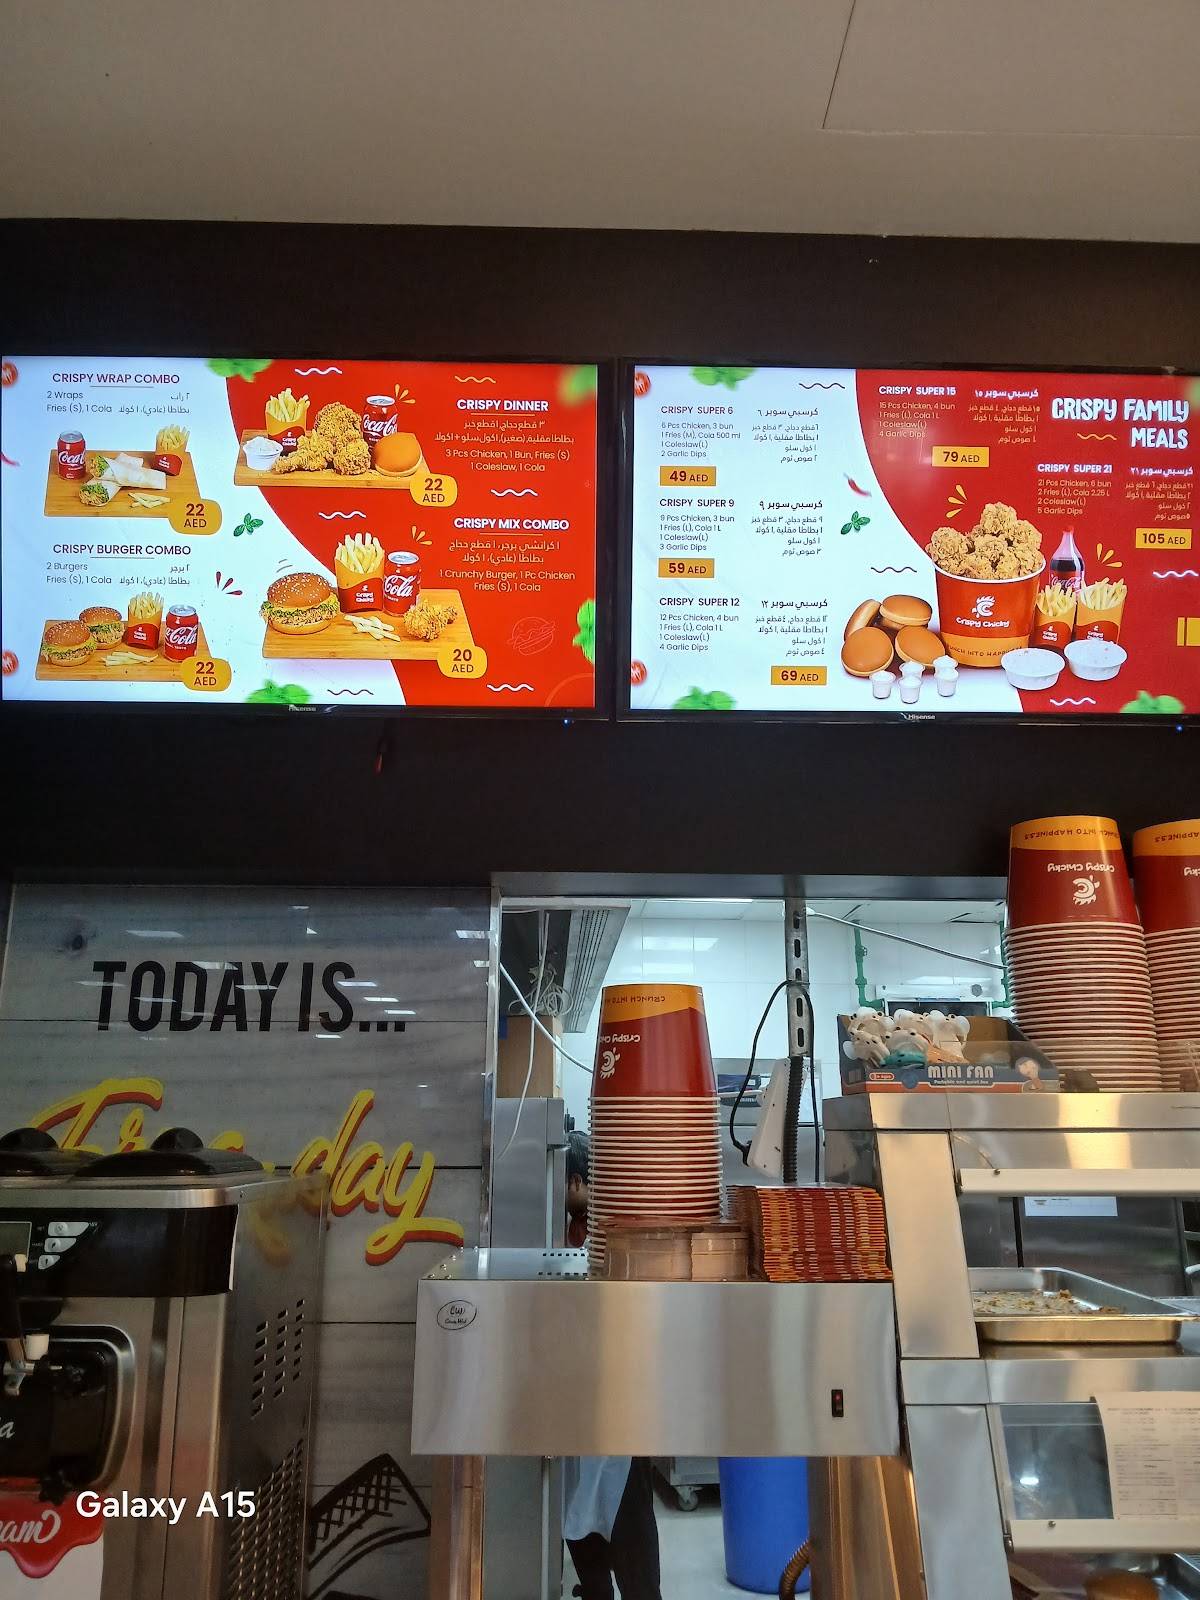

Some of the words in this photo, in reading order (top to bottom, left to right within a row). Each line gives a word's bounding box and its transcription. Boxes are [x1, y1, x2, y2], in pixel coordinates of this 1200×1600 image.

[52, 373, 94, 383] CRISPY
[96, 373, 132, 383] WRAP
[134, 374, 180, 384] COMBO
[54, 391, 84, 401] Wraps
[877, 385, 913, 395] CRISPY
[915, 386, 945, 396] SUPER
[946, 386, 957, 396] 15
[46, 403, 67, 413] Fries
[69, 402, 84, 414] (S),
[90, 404, 113, 413] Cola
[456, 399, 502, 411] CRISPY
[503, 400, 549, 412] DINNER
[660, 405, 694, 414] CRISPY
[697, 406, 726, 415] SUPER
[1051, 397, 1118, 422] CRISPY
[1123, 398, 1190, 424] FAMILY
[1131, 426, 1189, 450] MEALS
[451, 449, 470, 458] Pcs
[469, 449, 508, 460] Chicken,
[513, 449, 534, 460] Bun,
[534, 450, 556, 460] Fries
[556, 449, 570, 462] (S)
[943, 451, 959, 463] 79
[960, 454, 980, 463] AED
[475, 462, 518, 472] Coleslaw,
[523, 463, 546, 472] Cola
[1037, 463, 1071, 473] CRISPY
[1073, 463, 1102, 474] SUPER
[1103, 464, 1113, 474] 21
[669, 470, 687, 482] 49
[689, 474, 709, 482] AED
[424, 477, 443, 492] 22
[422, 493, 446, 503] AED
[659, 498, 693, 507] CRISPY
[697, 498, 727, 508] SUPER
[185, 503, 205, 517] 22
[183, 518, 207, 528] AED
[453, 517, 497, 529] CRISPY
[498, 518, 521, 529] MIX
[522, 519, 570, 531] COMBO
[1142, 532, 1165, 544] 105
[1167, 536, 1186, 545] AED
[52, 544, 94, 554] CRISPY
[97, 544, 143, 555] BURGER
[145, 545, 191, 555] COMBO
[53, 562, 88, 573] Burgers
[668, 562, 685, 574] 59
[687, 565, 707, 574] AED
[46, 575, 67, 584] Fries
[68, 573, 84, 585] (S),
[90, 575, 112, 584] Cola
[444, 569, 484, 581] Crunchy
[485, 570, 518, 582] Burger,
[524, 570, 537, 580] Pc
[537, 570, 576, 580] Chicken
[473, 581, 495, 592] Fries
[497, 580, 513, 593] (S),
[519, 582, 541, 592] Cola
[659, 597, 694, 606] CRISPY
[698, 597, 729, 607] SUPER
[730, 597, 740, 607] 12
[660, 613, 667, 621] 12
[668, 613, 682, 621] Pcs
[682, 613, 716, 623] Chicken,
[723, 614, 739, 622] bun
[666, 643, 690, 651] Garlic
[691, 643, 709, 653] Dips
[452, 648, 473, 662] 20
[195, 661, 215, 675] 22
[451, 663, 474, 673] AED
[193, 676, 217, 686] AED
[781, 670, 798, 681] 69
[799, 673, 819, 682] AED
[1024, 829, 1073, 840] HAPPINESS
[1047, 862, 1083, 873] Chicky
[1086, 862, 1115, 873] Crispy
[92, 961, 289, 1033] TODAY
[297, 961, 407, 1033] IS...
[612, 1034, 641, 1043] Crispy
[926, 1064, 962, 1079] MINI
[966, 1064, 994, 1079] FAN
